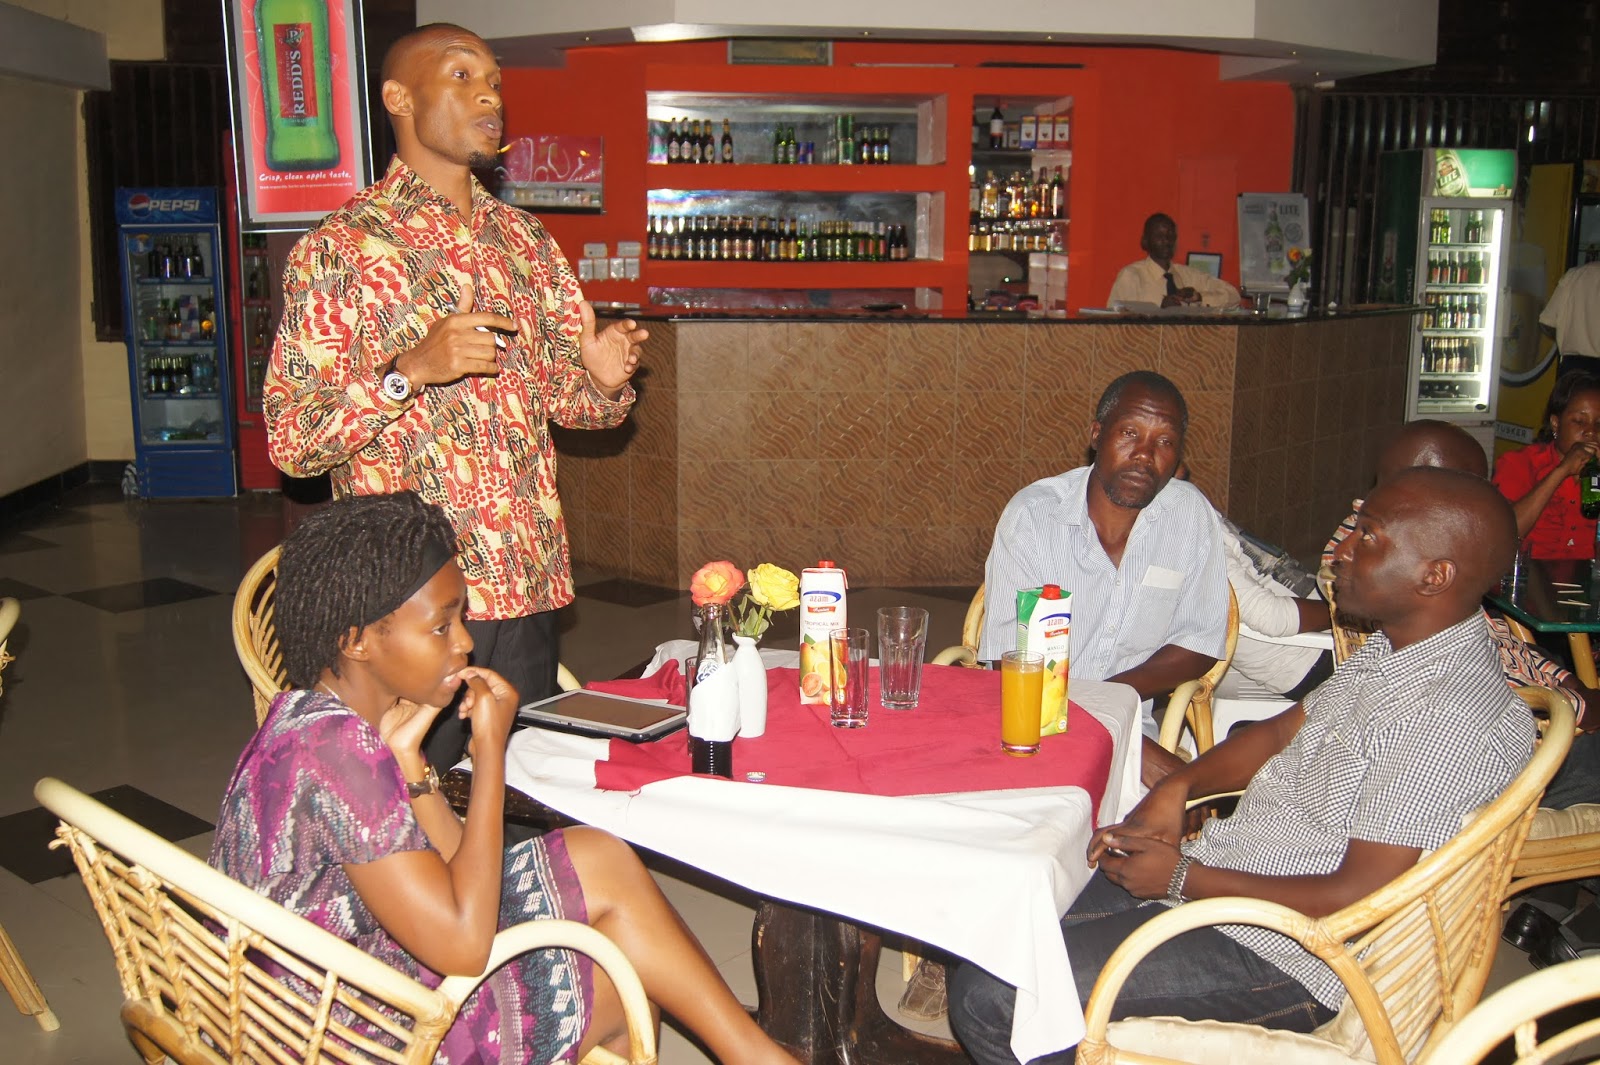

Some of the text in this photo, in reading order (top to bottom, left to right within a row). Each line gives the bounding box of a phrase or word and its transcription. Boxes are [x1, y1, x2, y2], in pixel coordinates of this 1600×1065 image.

[290, 50, 306, 115] REDD'S
[259, 170, 352, 182] Crisp, clean apple taste.
[1440, 169, 1458, 187] LITE
[148, 199, 201, 212] PEPSI
[1280, 204, 1299, 216] LITE
[1495, 423, 1527, 438] TUSKER
[809, 595, 829, 603] azam
[1046, 618, 1064, 627] azam
